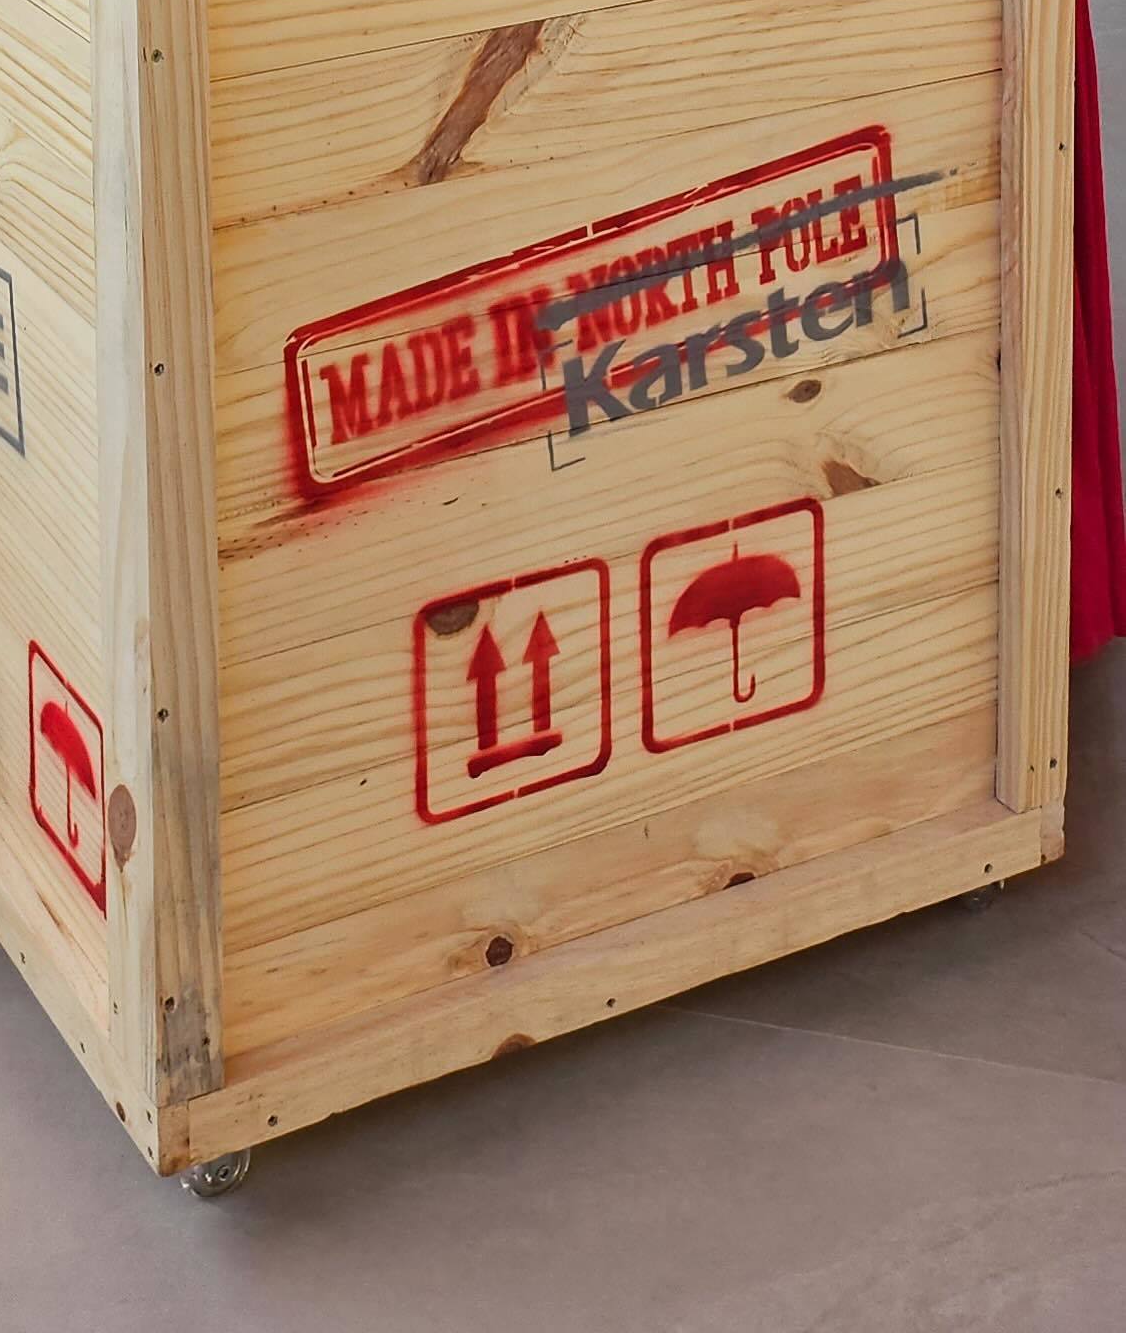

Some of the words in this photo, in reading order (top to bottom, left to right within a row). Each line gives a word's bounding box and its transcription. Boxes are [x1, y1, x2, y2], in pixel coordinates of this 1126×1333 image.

[319, 313, 482, 446] MADE
[488, 285, 556, 386] IN
[565, 219, 741, 353] NORTH
[750, 174, 868, 286] POLE
[562, 257, 911, 437] Karsten
